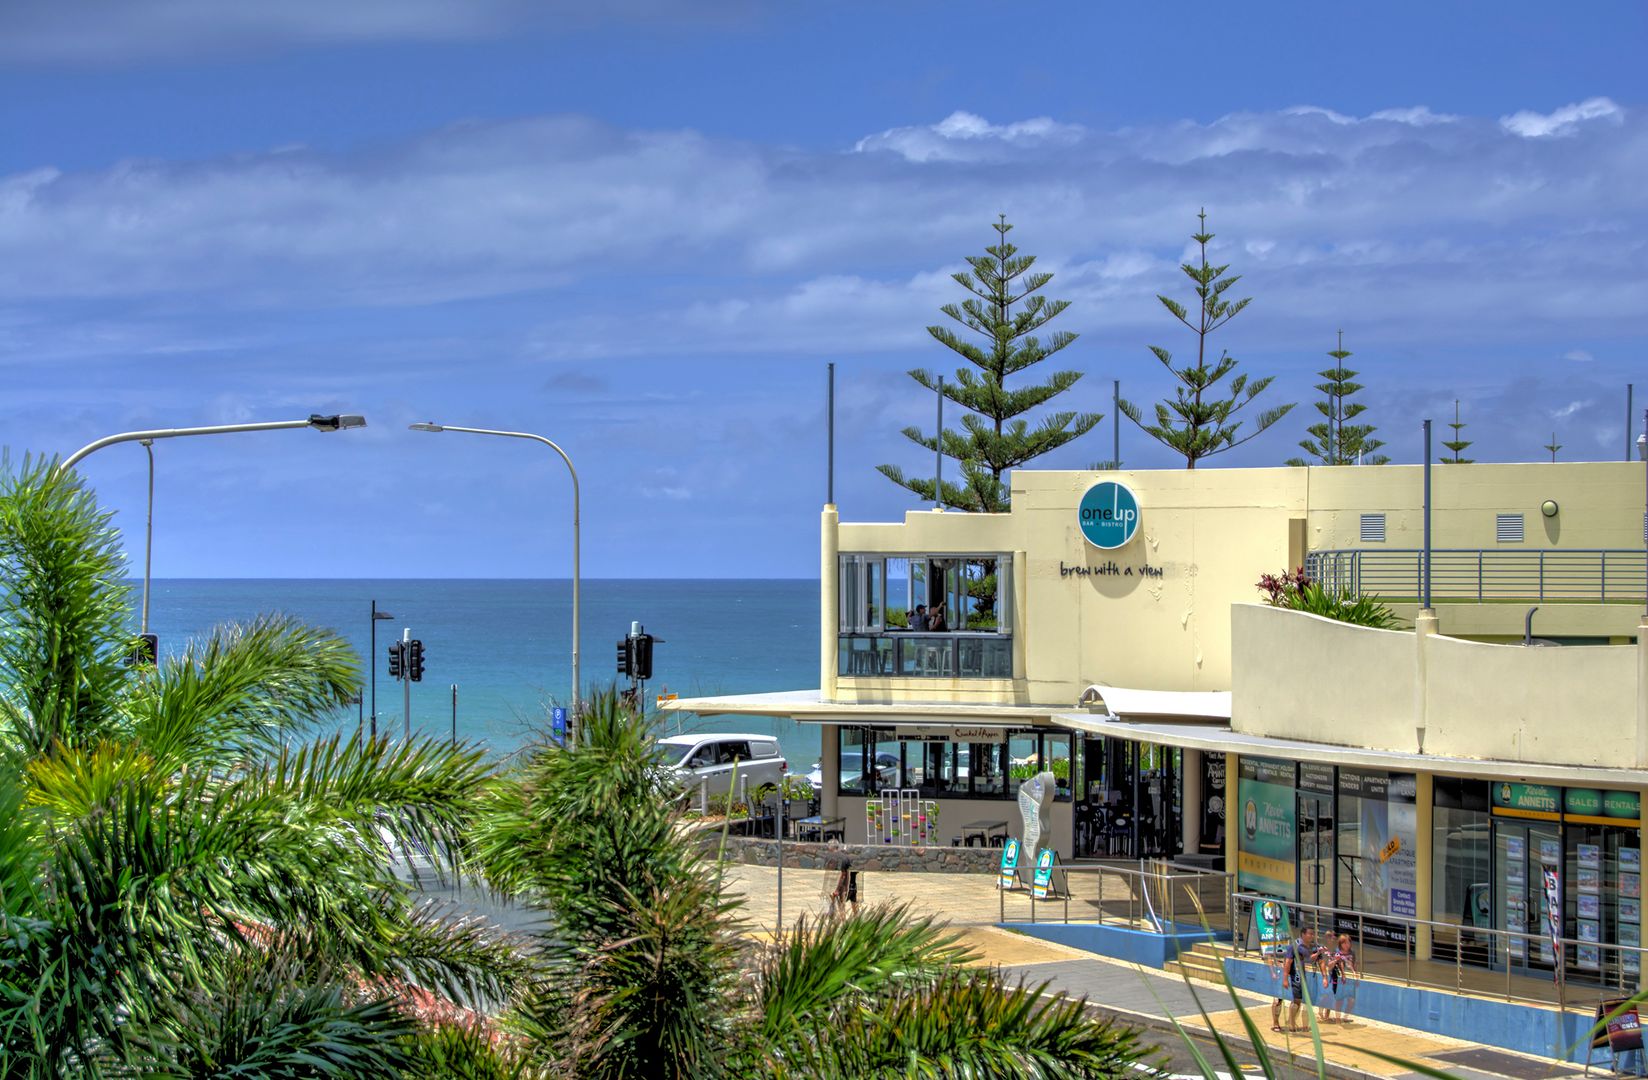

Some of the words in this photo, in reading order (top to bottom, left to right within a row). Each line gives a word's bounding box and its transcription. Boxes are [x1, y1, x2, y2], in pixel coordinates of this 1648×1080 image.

[1081, 508, 1113, 520] one
[1060, 561, 1091, 577] brew
[1094, 561, 1121, 576] with
[1124, 565, 1133, 577] a
[1139, 563, 1163, 577] view
[1518, 795, 1555, 809] ANNETTS
[1568, 797, 1599, 808] SALES
[1604, 799, 1640, 811] RENTALS
[1259, 816, 1291, 838] ANNETTS
[1338, 920, 1353, 929] LOCAL
